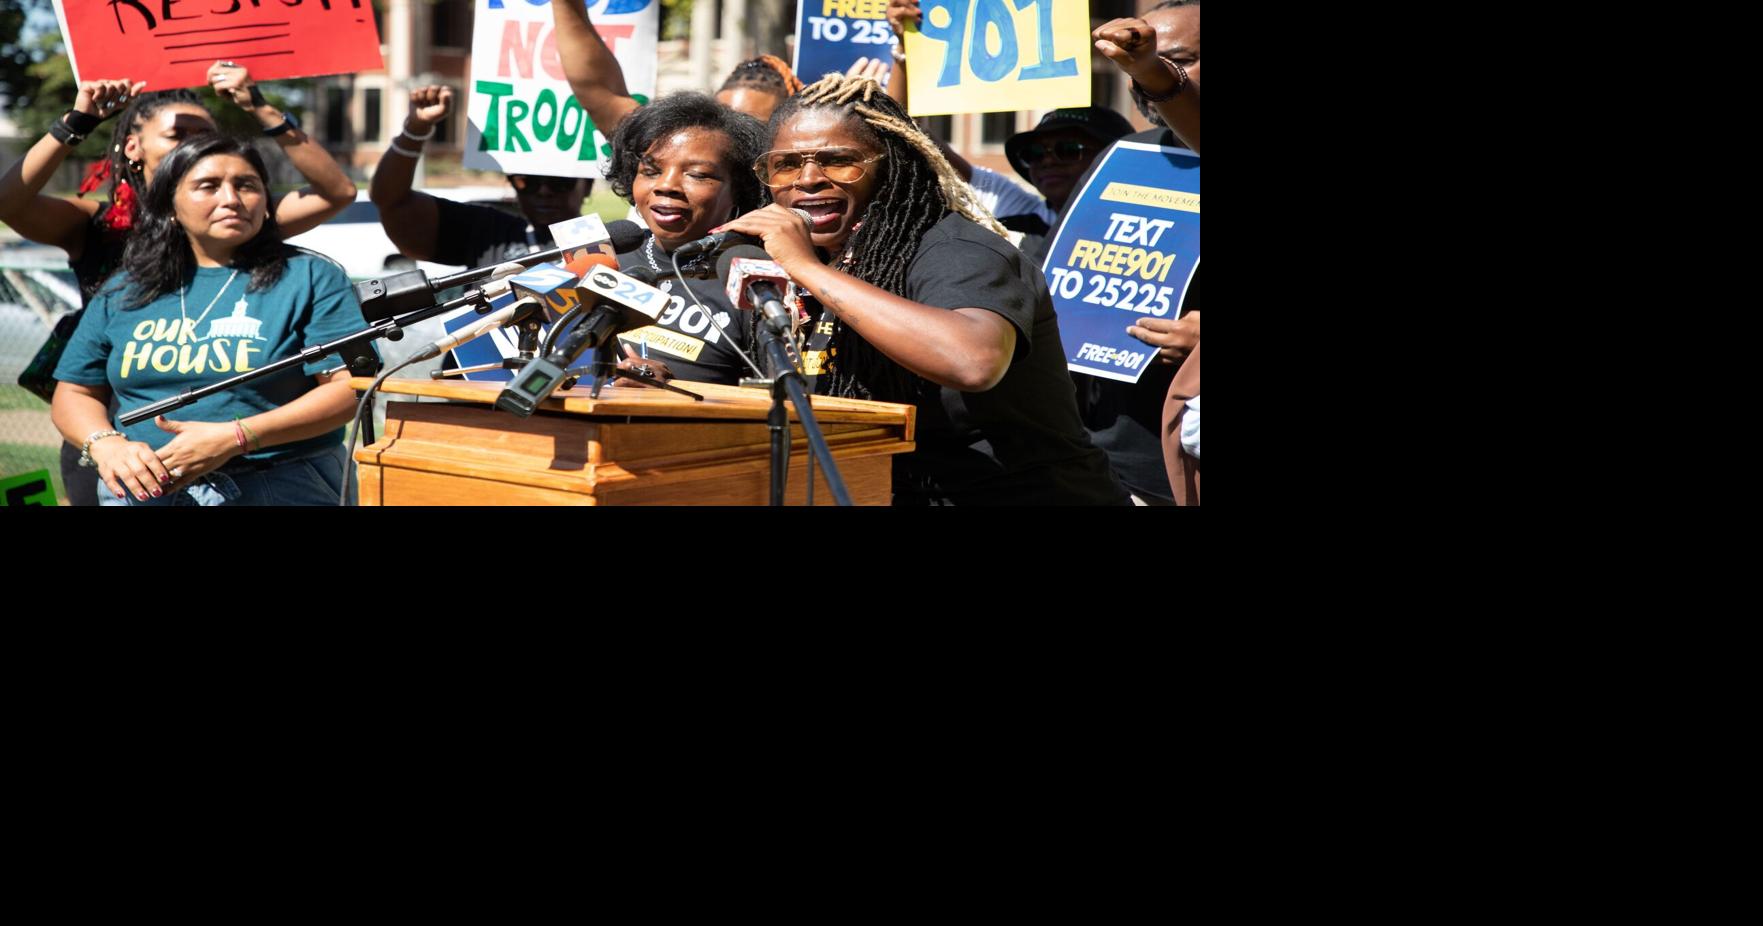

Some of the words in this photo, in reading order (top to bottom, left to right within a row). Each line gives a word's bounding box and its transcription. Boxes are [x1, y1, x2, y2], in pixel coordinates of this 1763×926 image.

[808, 16, 848, 42] TO
[919, 0, 1080, 88] 901
[476, 80, 650, 161] TROO
[1134, 190, 1150, 200] THE
[1103, 212, 1175, 248] TEXT
[1067, 239, 1177, 283] FREE901
[613, 281, 655, 305] 24
[1049, 266, 1085, 300] TO
[1082, 274, 1174, 318] 25225
[132, 316, 198, 346] OUR
[119, 337, 262, 379] HOUSE
